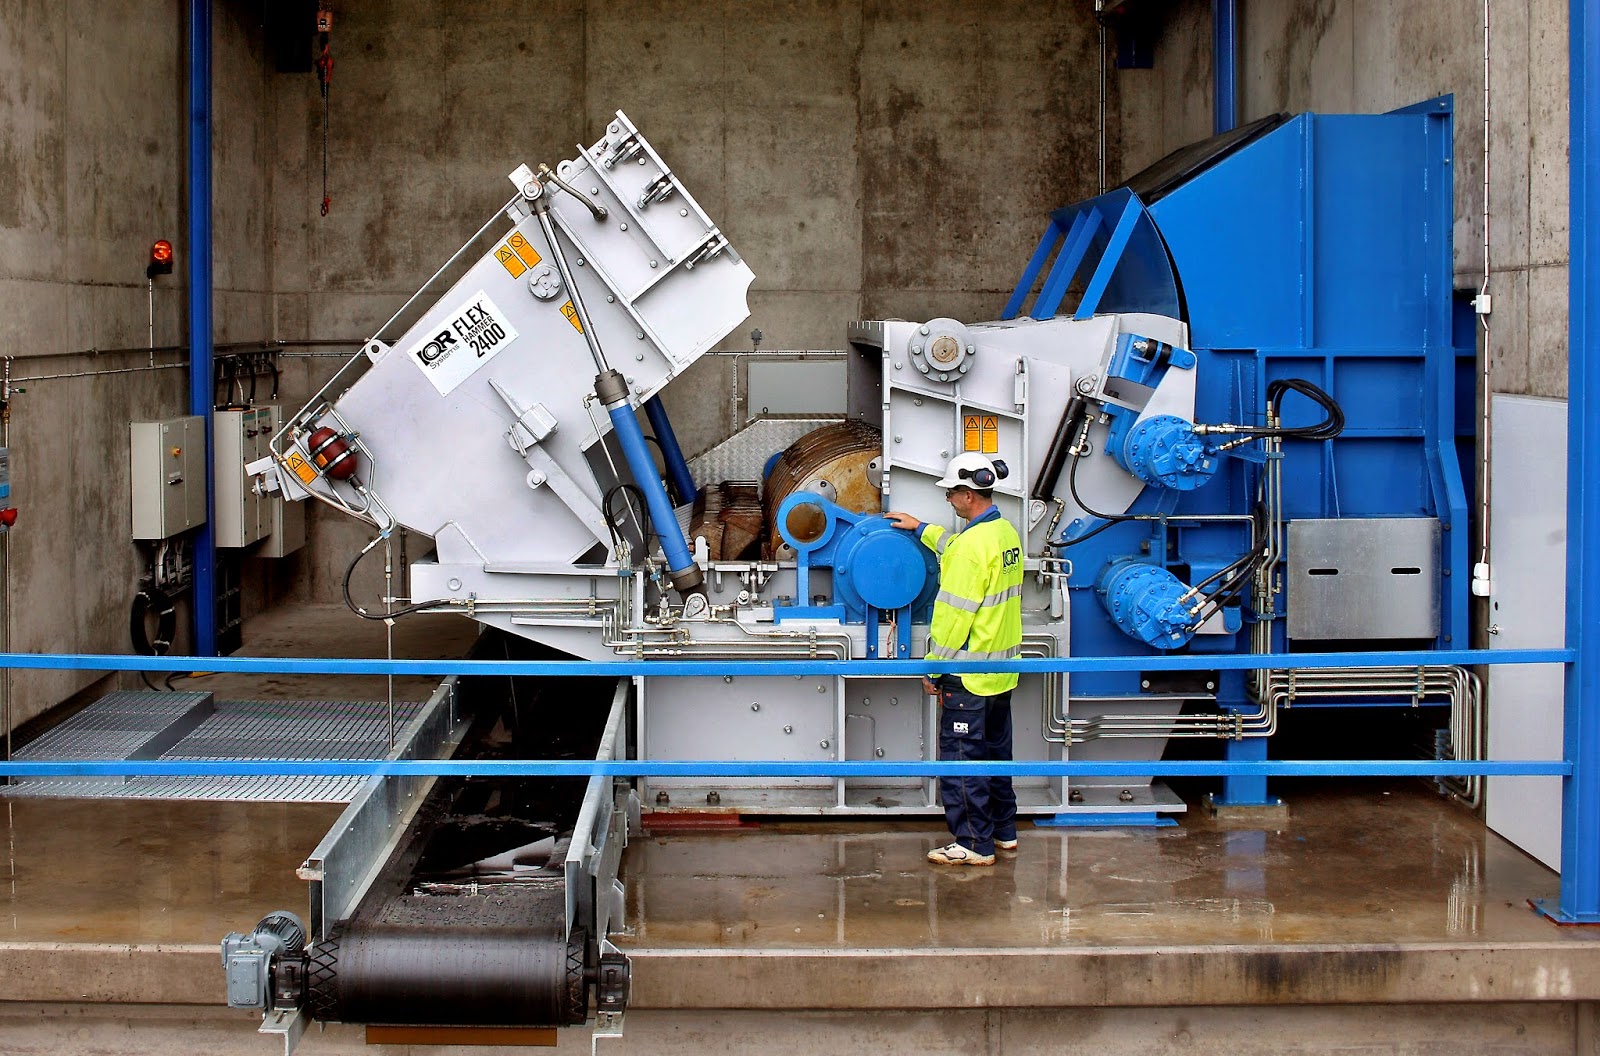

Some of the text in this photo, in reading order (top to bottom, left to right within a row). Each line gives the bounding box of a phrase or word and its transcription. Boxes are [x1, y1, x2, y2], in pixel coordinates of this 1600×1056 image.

[452, 302, 489, 337] FLEX
[463, 316, 495, 343] HAMMER
[416, 330, 458, 366] IQR
[429, 344, 460, 370] Systems
[469, 322, 506, 358] 2400
